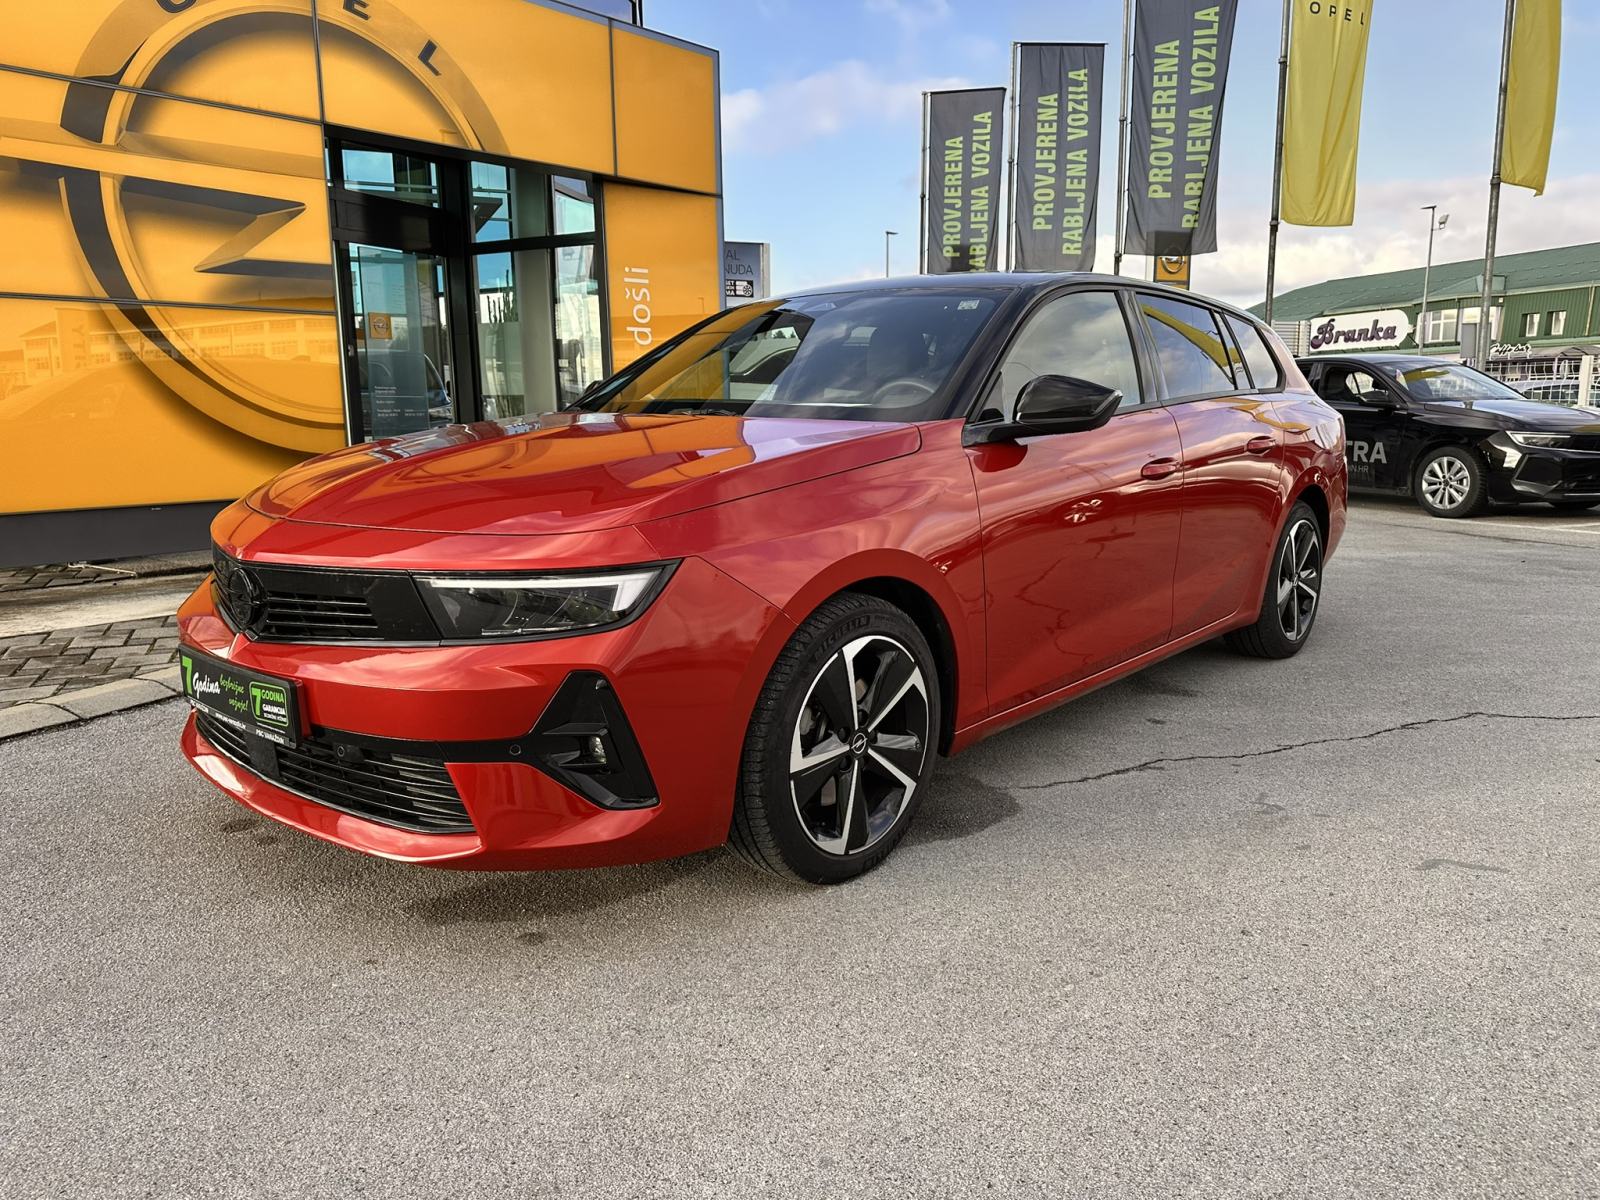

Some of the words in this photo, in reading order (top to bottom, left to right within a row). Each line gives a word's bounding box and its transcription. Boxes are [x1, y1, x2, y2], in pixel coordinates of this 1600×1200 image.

[1190, 6, 1220, 95] VOZILA
[1310, 1, 1364, 26] OPEL
[971, 111, 992, 178] VOZILA
[1066, 68, 1089, 143] VOZILA
[1148, 39, 1180, 199] PROVJERENA
[943, 136, 964, 257] PROVJERENA
[1032, 93, 1059, 231] PROVJERENA
[1062, 149, 1088, 255] RABLJENA
[1181, 104, 1213, 229] RABLJENA
[968, 185, 989, 272] ABLJENA
[624, 266, 652, 346] došli
[1310, 318, 1397, 349] Branka
[182, 655, 193, 696] 7
[193, 672, 220, 699] Godina
[251, 687, 261, 716] 7
[262, 690, 284, 703] GODINA
